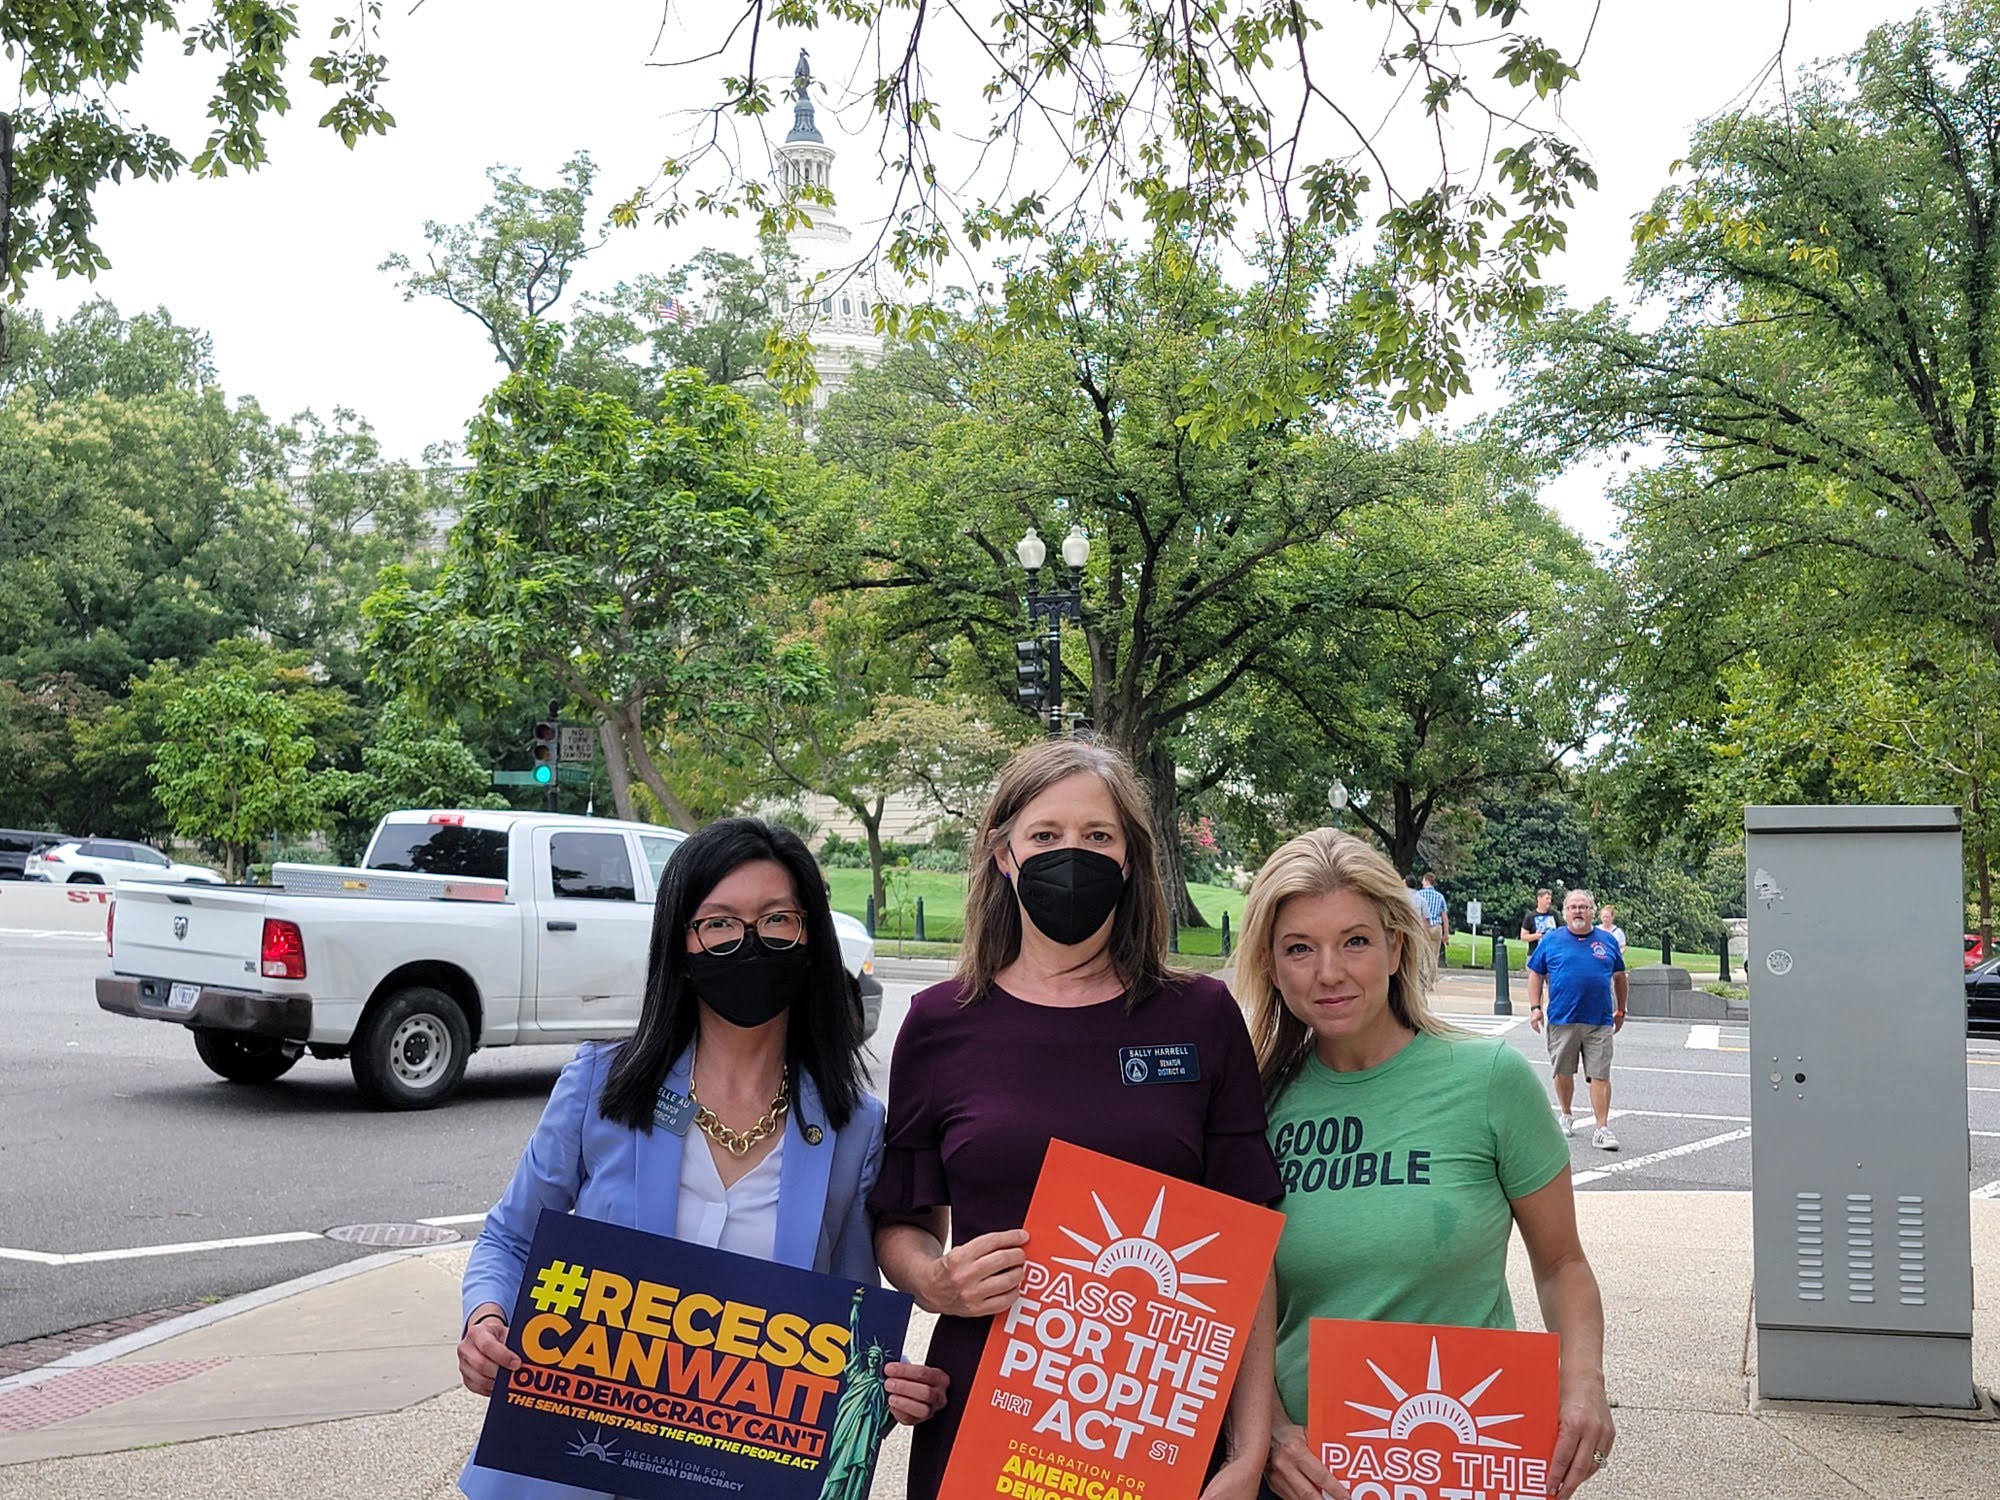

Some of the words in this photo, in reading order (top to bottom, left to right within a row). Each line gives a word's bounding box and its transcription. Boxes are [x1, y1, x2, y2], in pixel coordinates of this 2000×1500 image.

[1129, 1048, 1152, 1058] SALLY
[1154, 1046, 1189, 1056] HARRELL
[678, 1098, 691, 1108] AU
[1274, 1116, 1364, 1159] GOOD
[530, 1259, 853, 1378] #RECESS
[1019, 1260, 1137, 1327] PASS
[1145, 1302, 1236, 1361] THE
[1003, 1297, 1112, 1364] FOR
[1122, 1332, 1226, 1400] THE
[513, 1367, 571, 1397] OUR
[574, 1379, 742, 1434] DEMOCRACY
[744, 1418, 824, 1452] CAN'T
[991, 1389, 1032, 1416] HR1
[999, 1338, 1204, 1438] PEOPLE
[507, 1392, 534, 1408] THE
[534, 1398, 588, 1420] SENATE
[587, 1410, 625, 1427] MUST
[624, 1418, 658, 1435] PASS
[659, 1426, 688, 1442] THE
[685, 1433, 716, 1448] FOR
[714, 1438, 742, 1455] THE
[740, 1444, 796, 1466] PEOPLE
[790, 1456, 819, 1471] ACT
[1032, 1399, 1144, 1460] ACT
[1149, 1440, 1179, 1466] S1
[621, 1458, 678, 1478] AMERICAN
[679, 1470, 744, 1492] DEMOCRACY
[624, 1450, 701, 1473] DECLARATION
[704, 1467, 726, 1478] FOR
[1008, 1439, 1111, 1481] DECLARATION
[1116, 1474, 1146, 1492] FOR
[1321, 1442, 1441, 1484] PASS
[1452, 1452, 1548, 1494] THE
